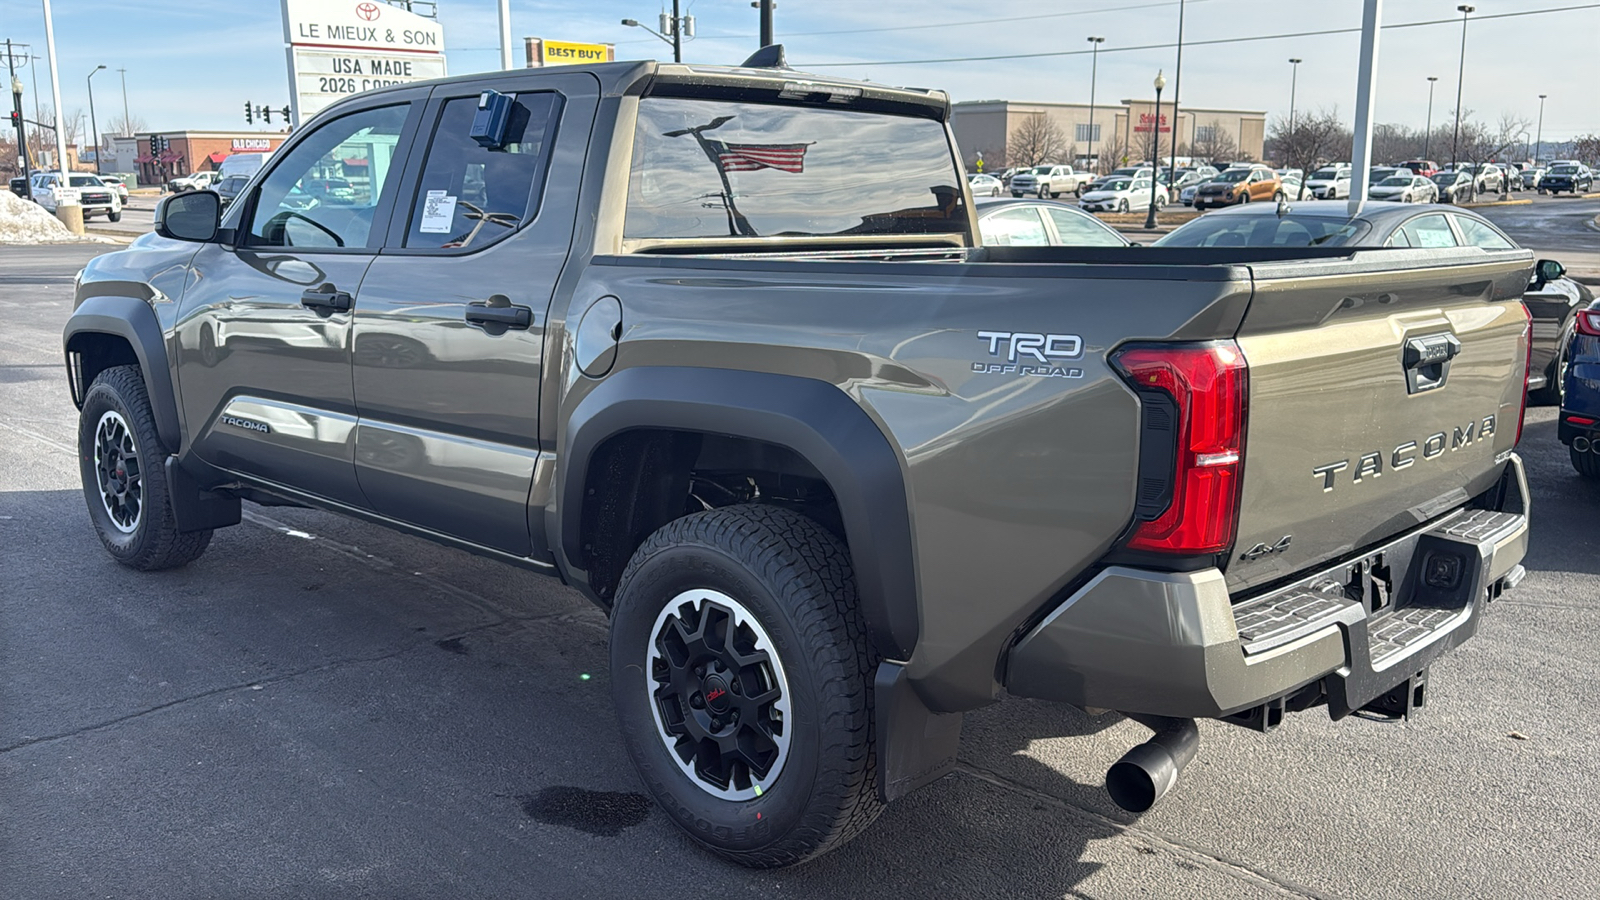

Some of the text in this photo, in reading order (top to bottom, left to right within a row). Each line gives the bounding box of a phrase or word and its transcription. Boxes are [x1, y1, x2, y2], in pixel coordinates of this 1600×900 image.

[299, 23, 436, 46] LE MIEUX & SON
[548, 47, 603, 60] BEST BUY
[333, 57, 412, 76] USA MADE
[319, 77, 356, 93] 2026
[232, 138, 271, 149] OLD CHICAGO
[977, 330, 1085, 364] TRD
[971, 361, 1084, 379] OFF ROAD
[222, 415, 268, 433] TACOMA
[1313, 413, 1496, 493] TACOMA
[706, 688, 726, 702] TRD
